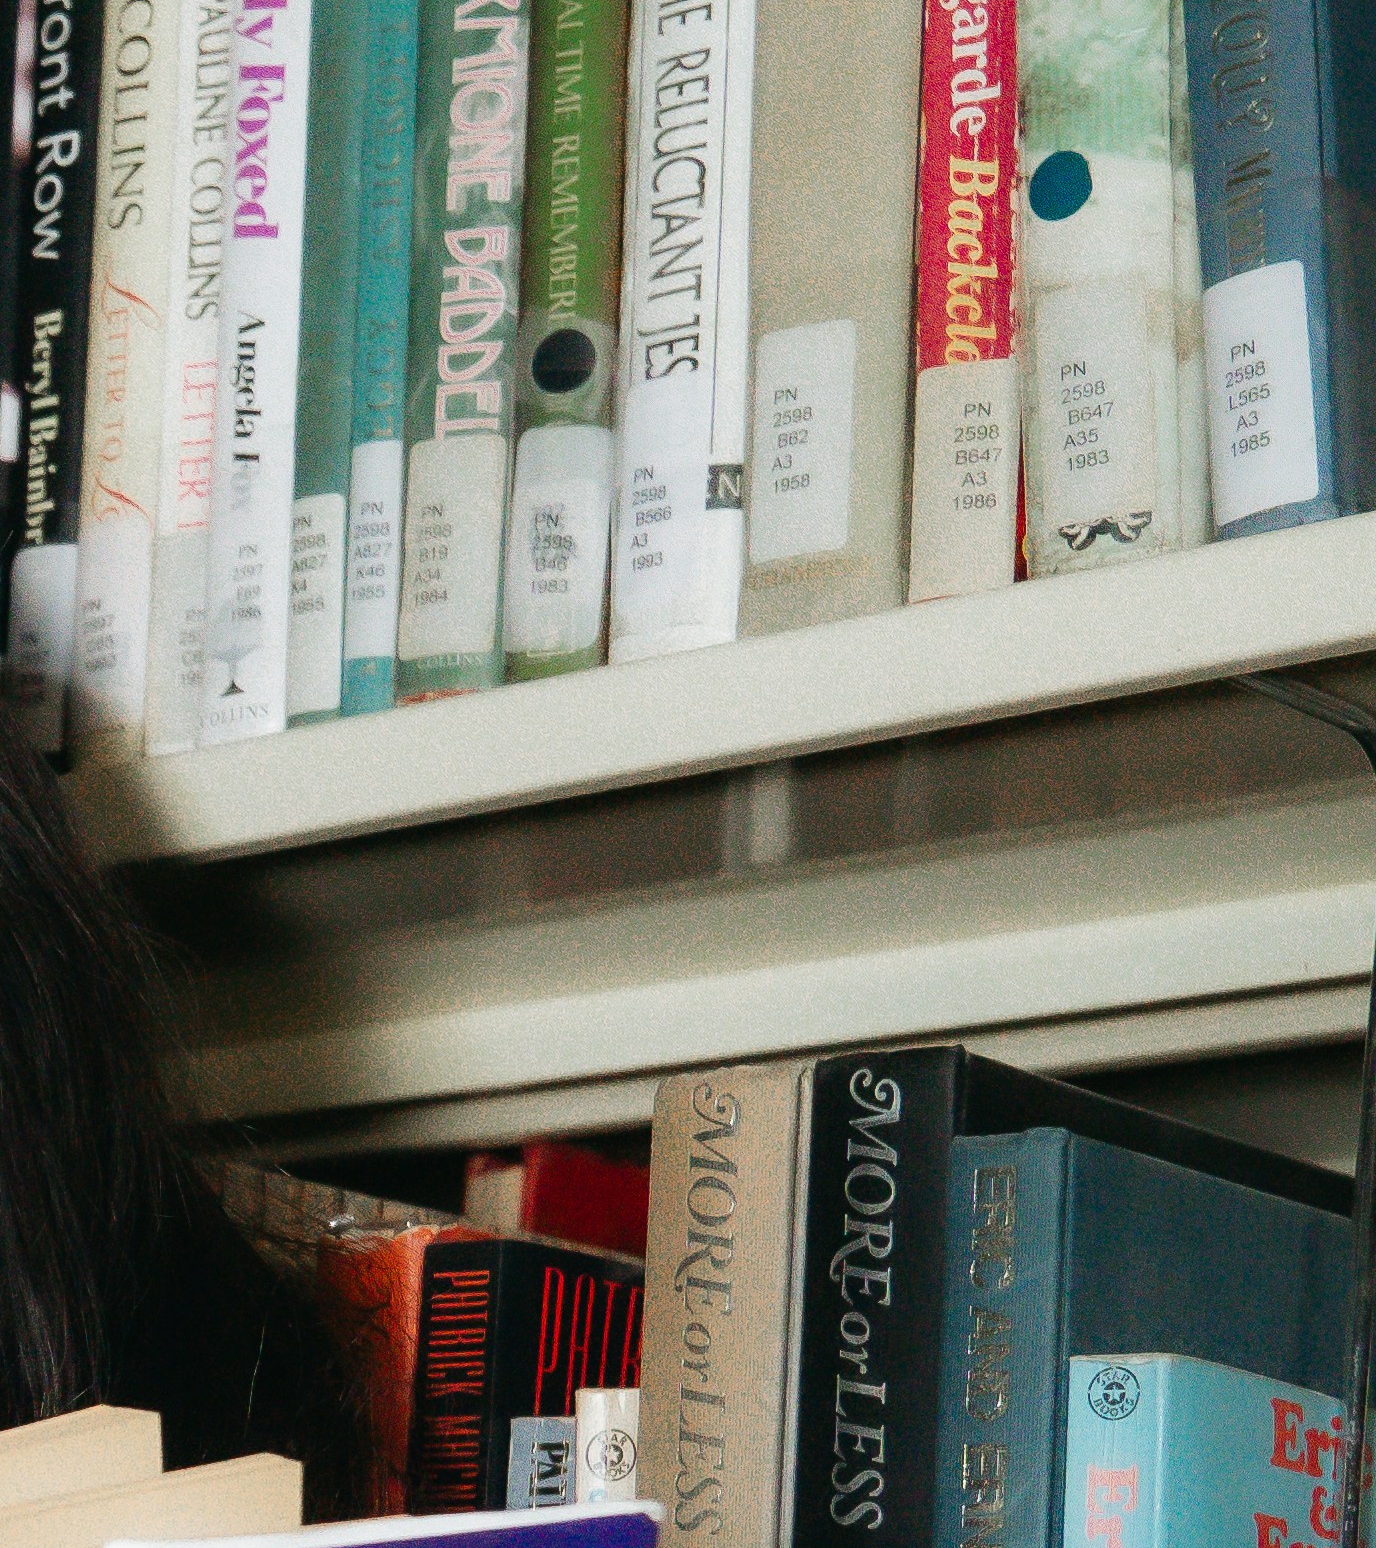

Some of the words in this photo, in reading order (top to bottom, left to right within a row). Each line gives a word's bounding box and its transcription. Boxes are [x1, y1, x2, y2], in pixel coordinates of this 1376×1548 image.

[554, 38, 585, 127] TIME
[233, 63, 287, 240] Foxed
[647, 47, 711, 301] RELUCTANT
[32, 130, 81, 260] Row
[186, 156, 228, 321] COLLINS
[25, 309, 62, 412] Beryl
[1230, 339, 1256, 360] PN
[230, 310, 266, 439] Angela
[1060, 361, 1087, 381] PN
[1225, 361, 1266, 388] 2598
[773, 388, 799, 404] PN
[1061, 381, 1107, 405] 2598
[772, 407, 813, 429] 2598
[963, 402, 992, 418] PN
[1236, 412, 1260, 432] A3
[177, 360, 218, 502] LETTER
[954, 424, 1000, 443] 2598
[1063, 429, 1099, 450] A35
[1230, 432, 1271, 458] 1985
[772, 455, 793, 472] A3
[1066, 450, 1109, 471] 1983
[773, 474, 811, 494] 1958
[962, 470, 988, 488] A3
[953, 494, 998, 511] 1986
[674, 1081, 741, 1315] MORE
[829, 1067, 903, 1307] MORE
[969, 1165, 1017, 1290] ERIC
[426, 1270, 490, 1398] PATRICK
[840, 1311, 871, 1375] or
[681, 1322, 712, 1383] or
[965, 1305, 1011, 1421] AND
[1095, 1366, 1132, 1388] STAR
[1092, 1395, 1136, 1420] BOOKS
[674, 1382, 727, 1536] LESS
[830, 1373, 887, 1530] LESS
